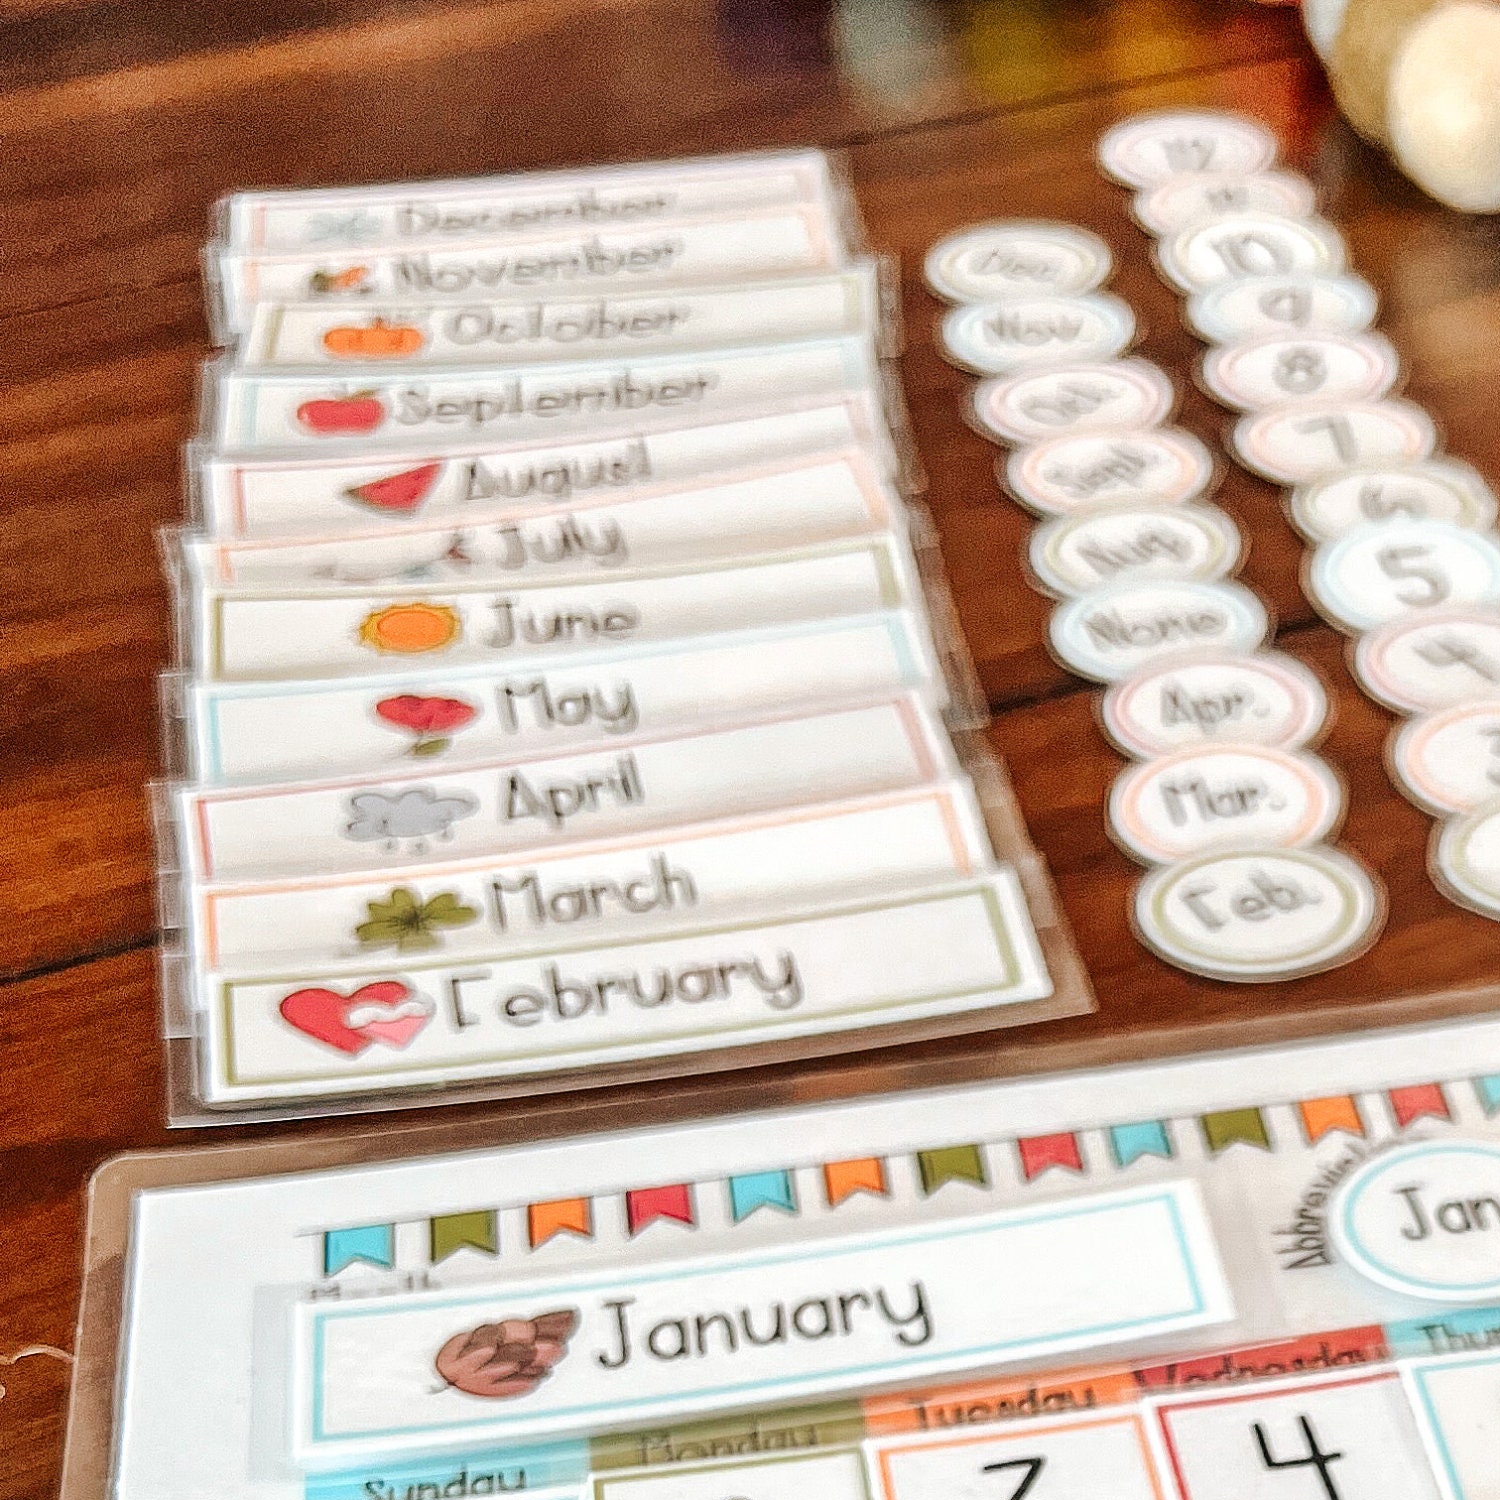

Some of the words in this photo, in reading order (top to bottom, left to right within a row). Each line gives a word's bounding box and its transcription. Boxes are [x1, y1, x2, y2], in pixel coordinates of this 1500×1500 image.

[392, 234, 684, 293] November
[446, 298, 690, 346] October
[394, 368, 720, 428] September
[1272, 350, 1328, 394] 8
[460, 436, 652, 501] August
[1295, 415, 1357, 464] 7
[497, 513, 630, 570] July
[1374, 543, 1452, 606] 5
[486, 598, 640, 648] June
[496, 678, 640, 735] May
[500, 751, 645, 829] April
[486, 852, 698, 934] March
[445, 950, 803, 1033] February
[596, 1278, 938, 1370] January
